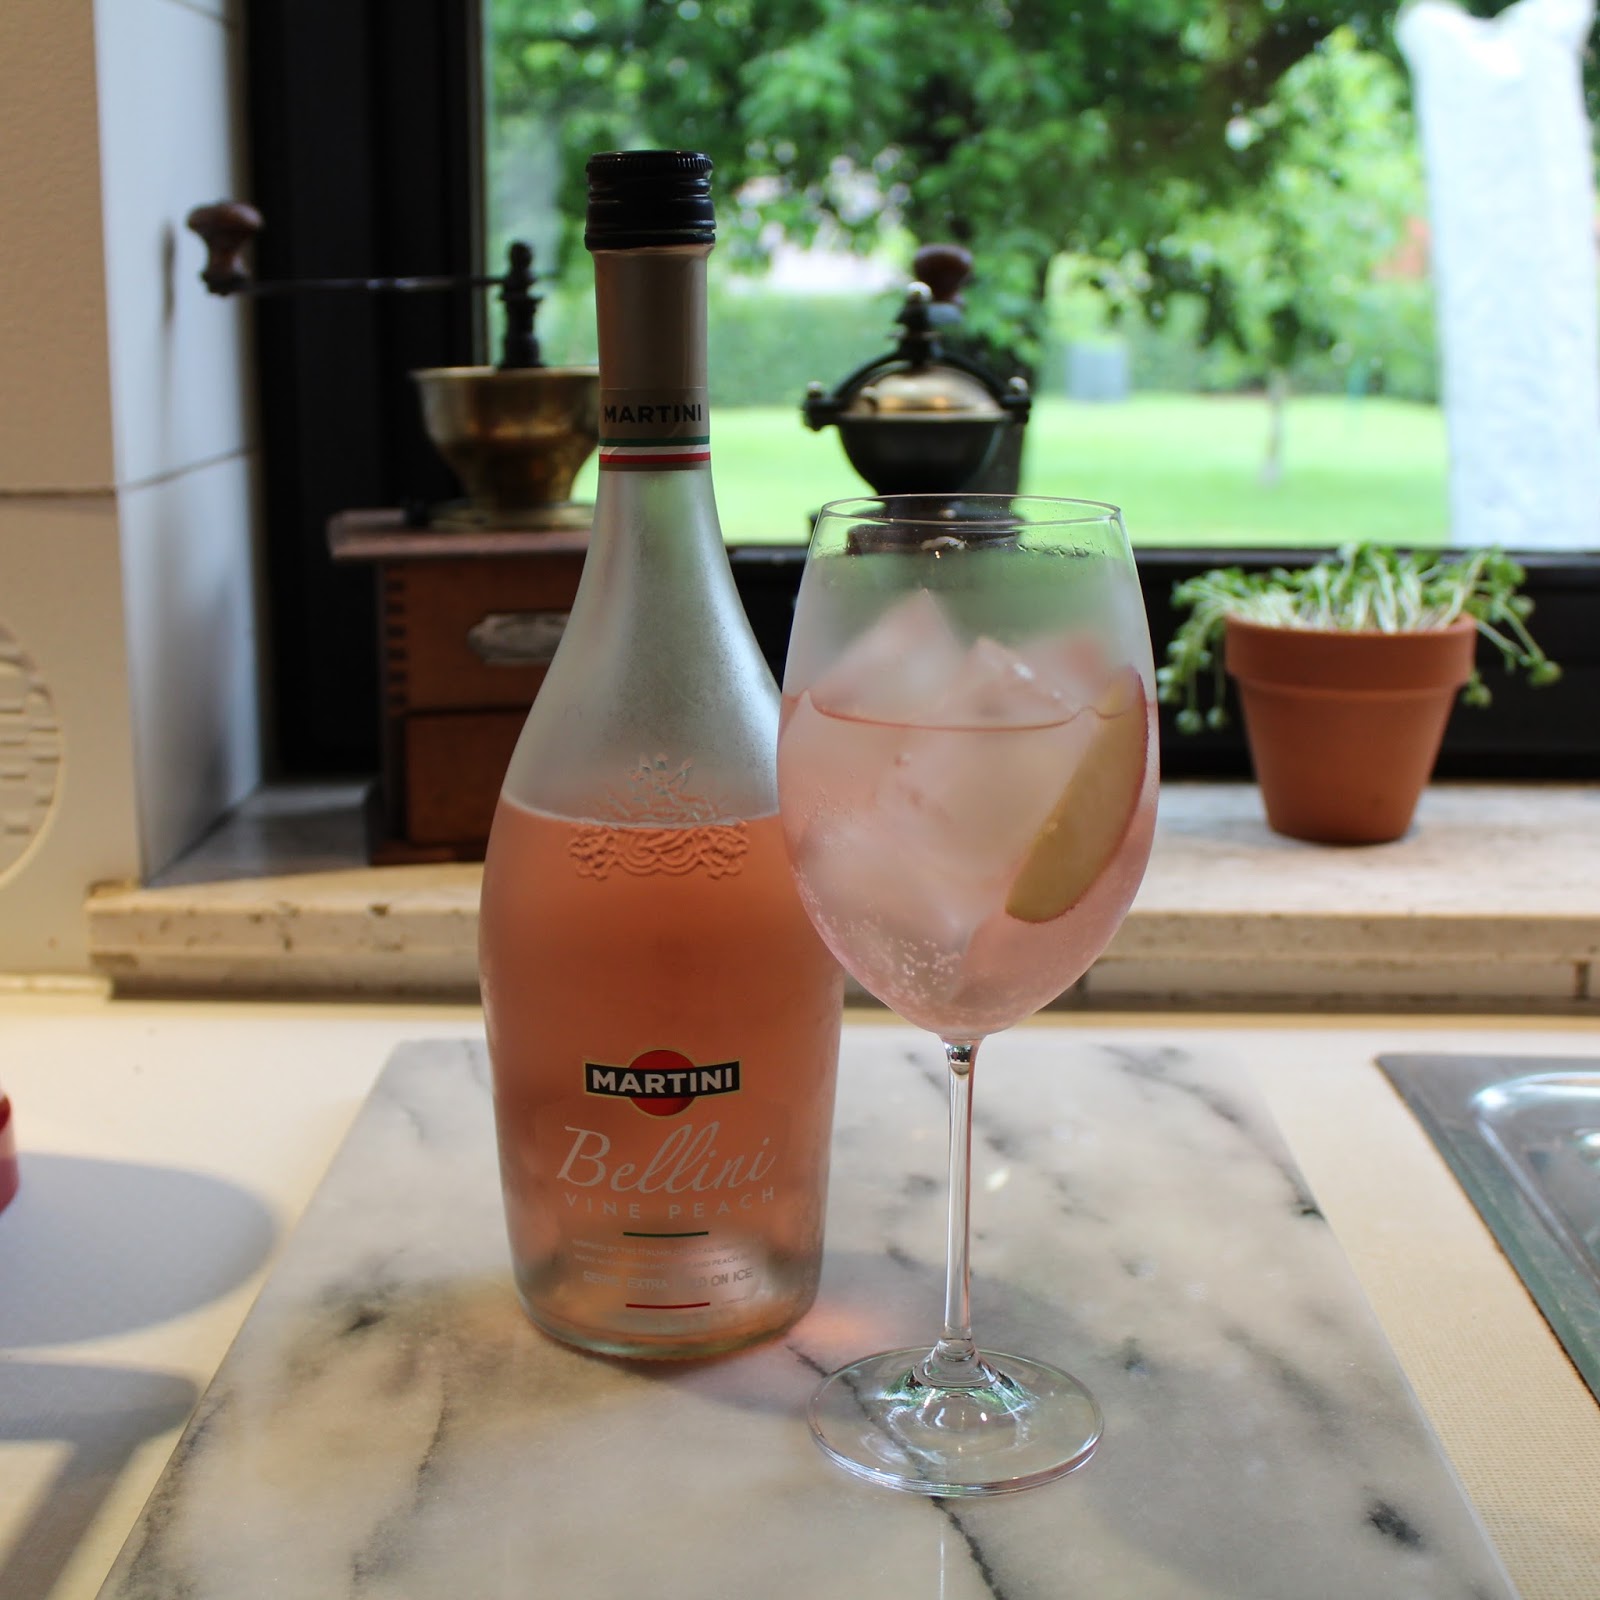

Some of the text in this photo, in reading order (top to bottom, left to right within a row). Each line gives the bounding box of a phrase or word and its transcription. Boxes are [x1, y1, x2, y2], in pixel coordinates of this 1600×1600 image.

[604, 404, 702, 423] MARTINI
[592, 1068, 733, 1094] MARTINI
[556, 1121, 776, 1194] Bellini
[565, 1186, 774, 1219] VINE PEACH
[711, 1255, 739, 1266] PEACH
[627, 1276, 668, 1291] EXTRA
[711, 1273, 729, 1287] ON
[733, 1267, 754, 1282] ICE
